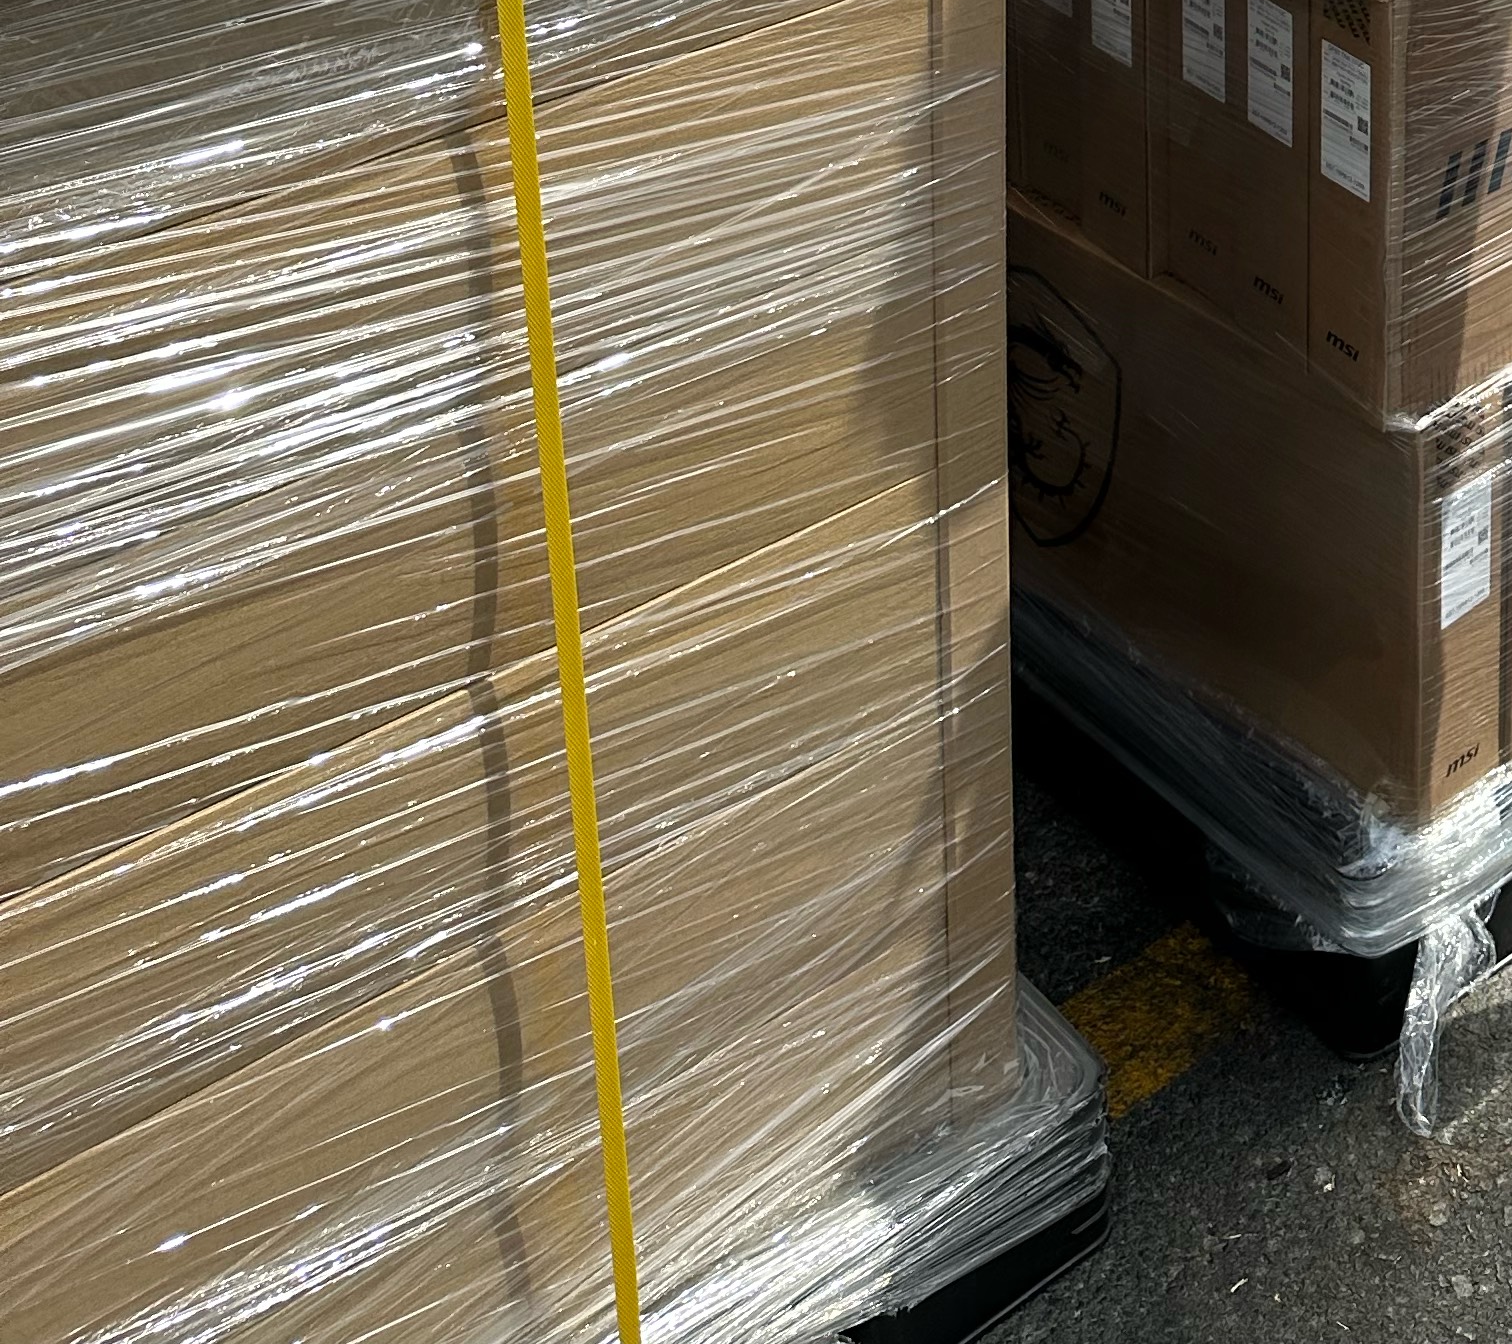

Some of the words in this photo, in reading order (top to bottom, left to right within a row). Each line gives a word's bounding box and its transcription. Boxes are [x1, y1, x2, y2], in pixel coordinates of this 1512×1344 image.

[1253, 274, 1284, 306] msi
[1325, 329, 1360, 363] msi
[1446, 744, 1479, 778] msi
